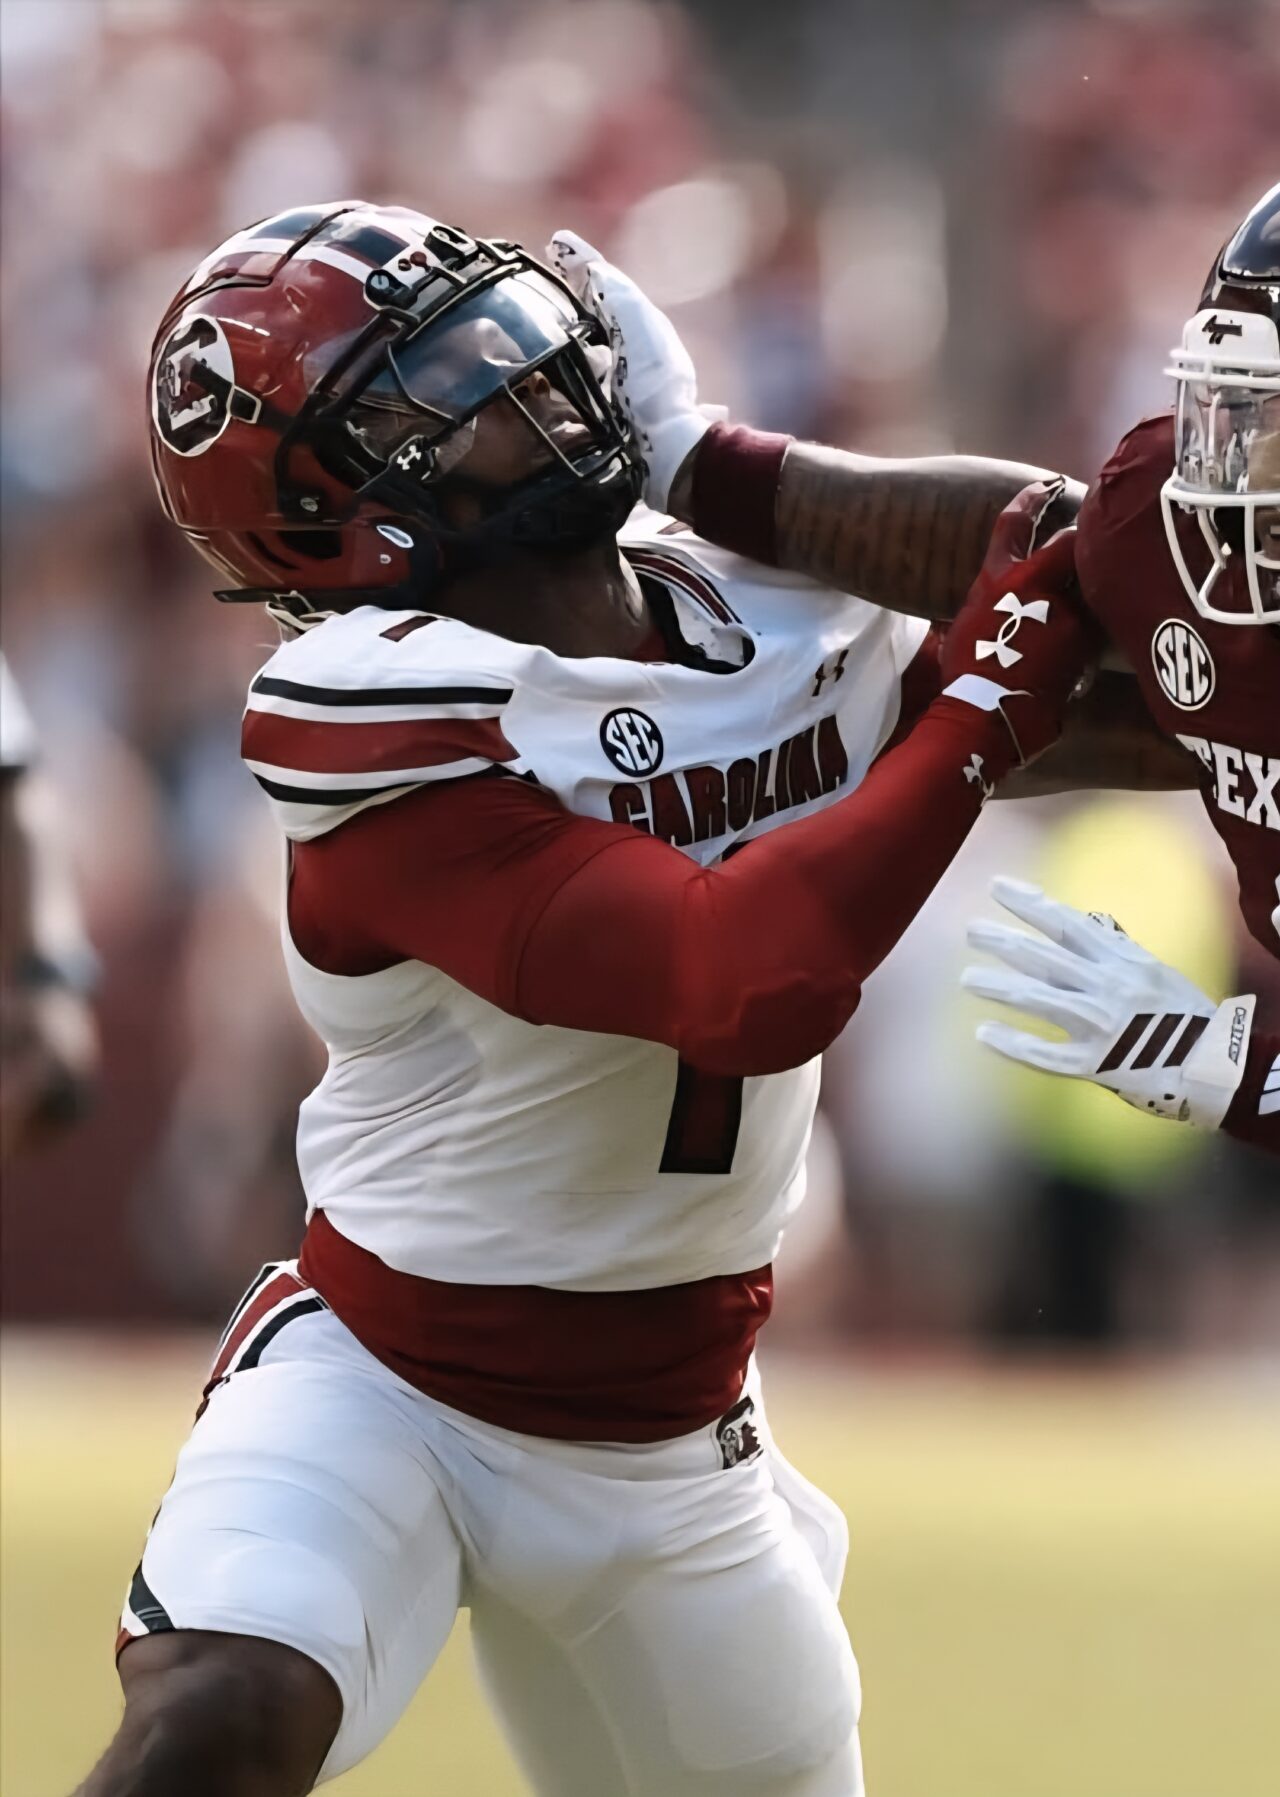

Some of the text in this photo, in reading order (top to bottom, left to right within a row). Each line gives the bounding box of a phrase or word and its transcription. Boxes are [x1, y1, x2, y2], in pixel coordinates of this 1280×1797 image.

[1157, 624, 1209, 704] SEC
[605, 711, 660, 772] SEC
[608, 714, 848, 847] CAROLINA
